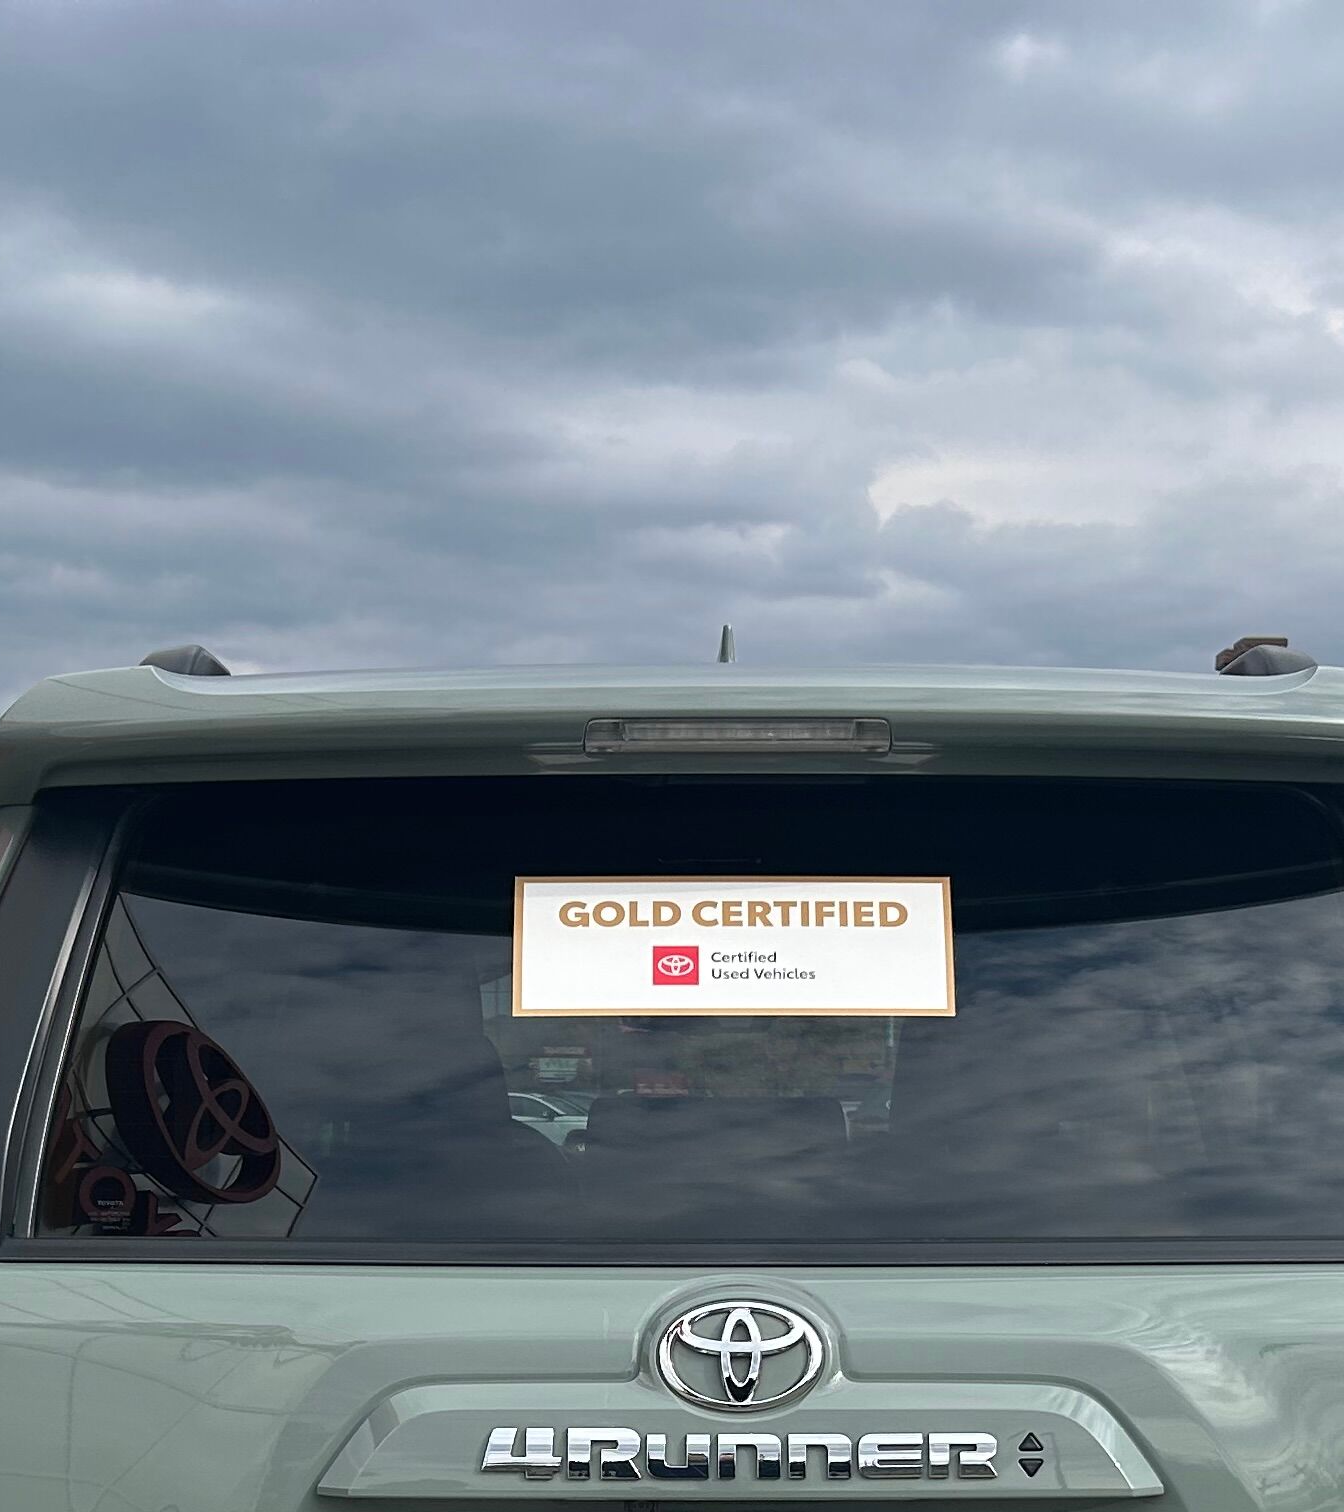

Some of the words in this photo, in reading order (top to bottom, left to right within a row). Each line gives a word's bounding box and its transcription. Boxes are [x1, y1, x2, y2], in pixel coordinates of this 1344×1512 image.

[558, 900, 682, 928] GOLD
[691, 900, 909, 928] CERTIFIED
[711, 951, 777, 963] Certified
[711, 968, 750, 980] Used
[753, 968, 816, 980] Vehicles
